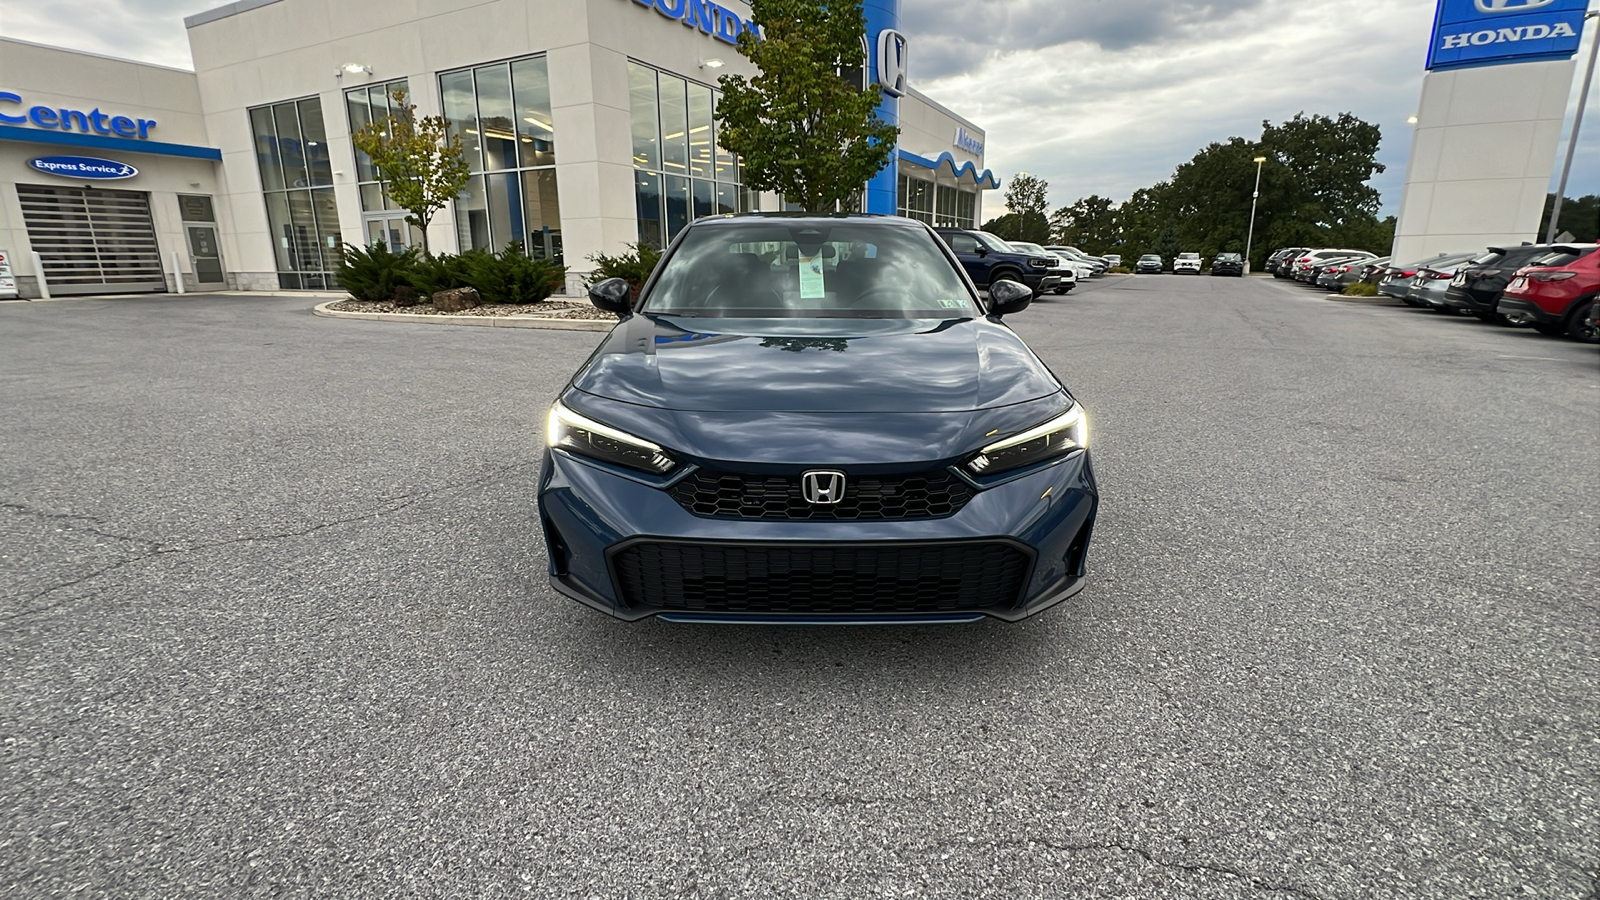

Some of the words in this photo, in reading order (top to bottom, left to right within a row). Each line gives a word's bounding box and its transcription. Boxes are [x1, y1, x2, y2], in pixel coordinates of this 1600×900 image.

[1441, 22, 1576, 49] HONDA
[0, 91, 157, 139] Center
[35, 160, 78, 171] Express
[79, 163, 117, 174] Service
